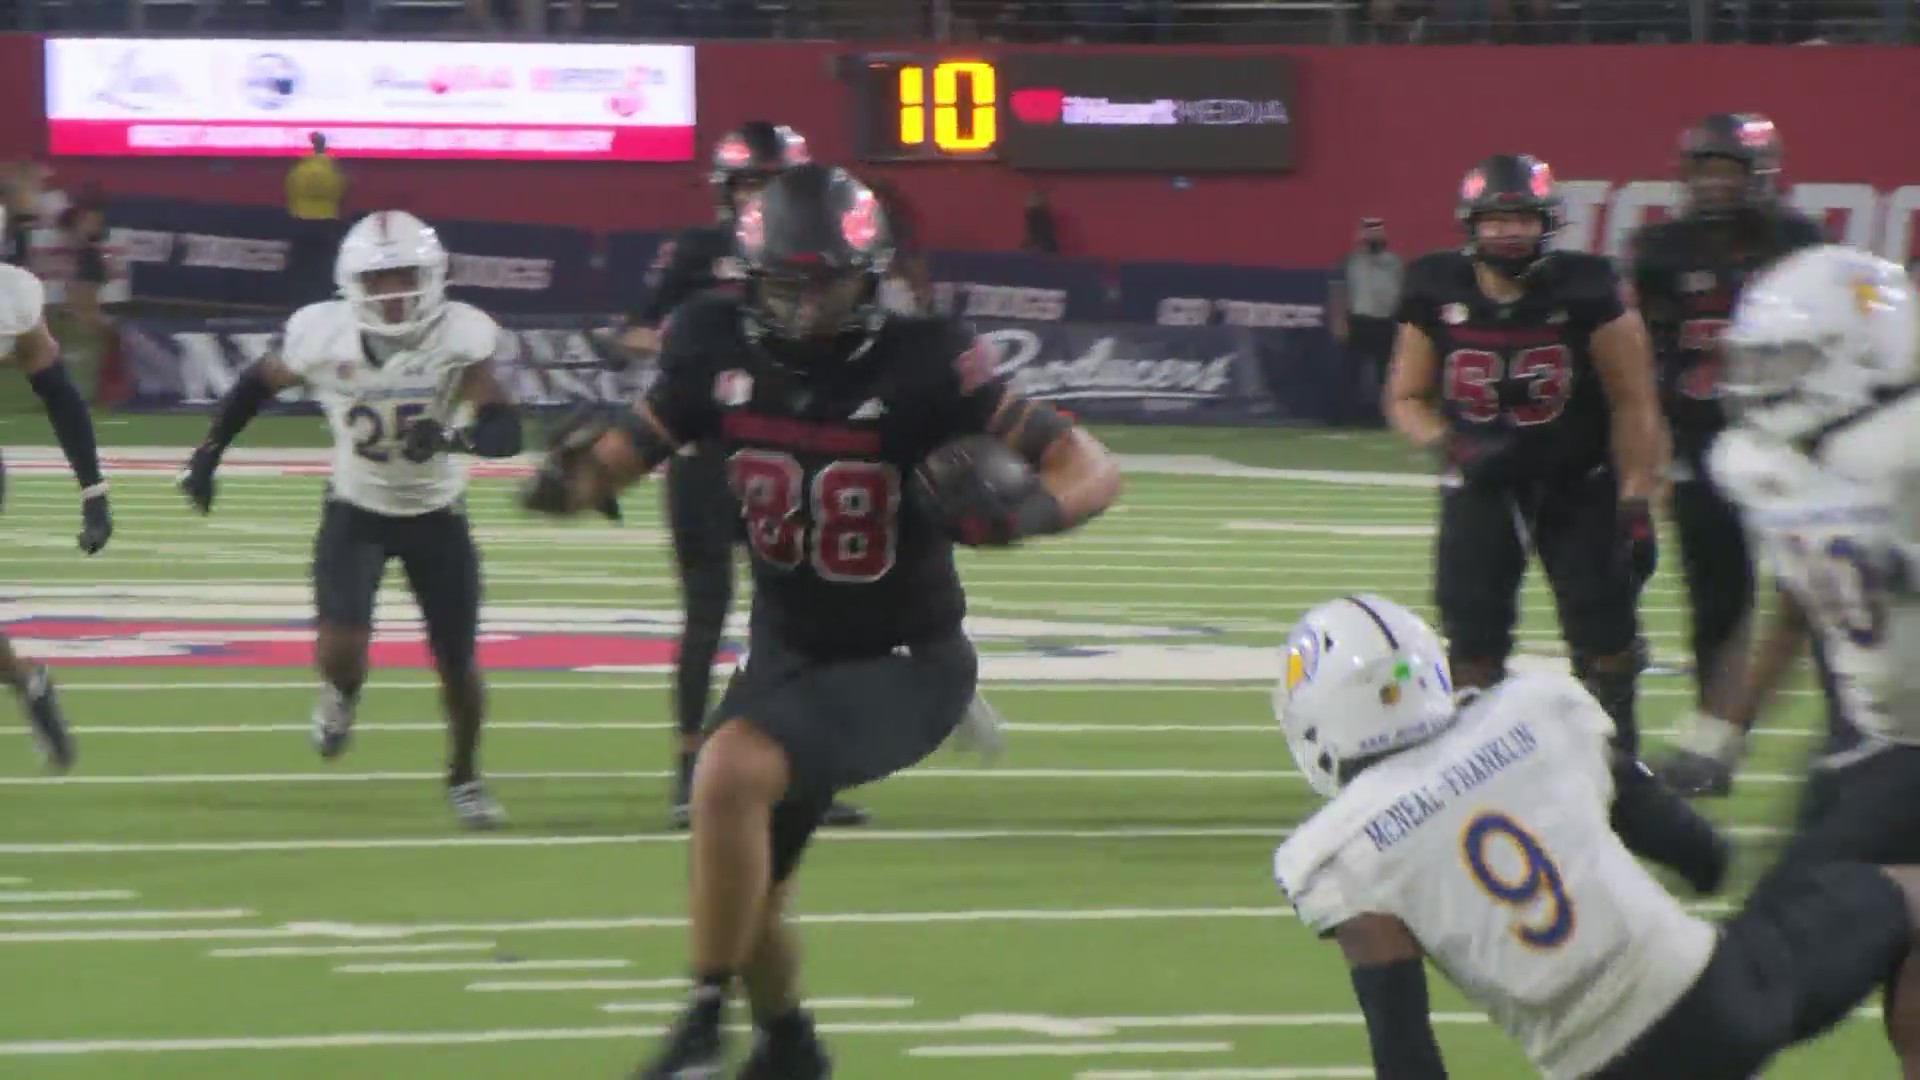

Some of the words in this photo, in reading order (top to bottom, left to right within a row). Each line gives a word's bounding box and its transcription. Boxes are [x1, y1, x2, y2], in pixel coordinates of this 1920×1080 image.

[898, 61, 996, 152] 10
[728, 448, 902, 583] 88
[1459, 809, 1577, 951] 9
